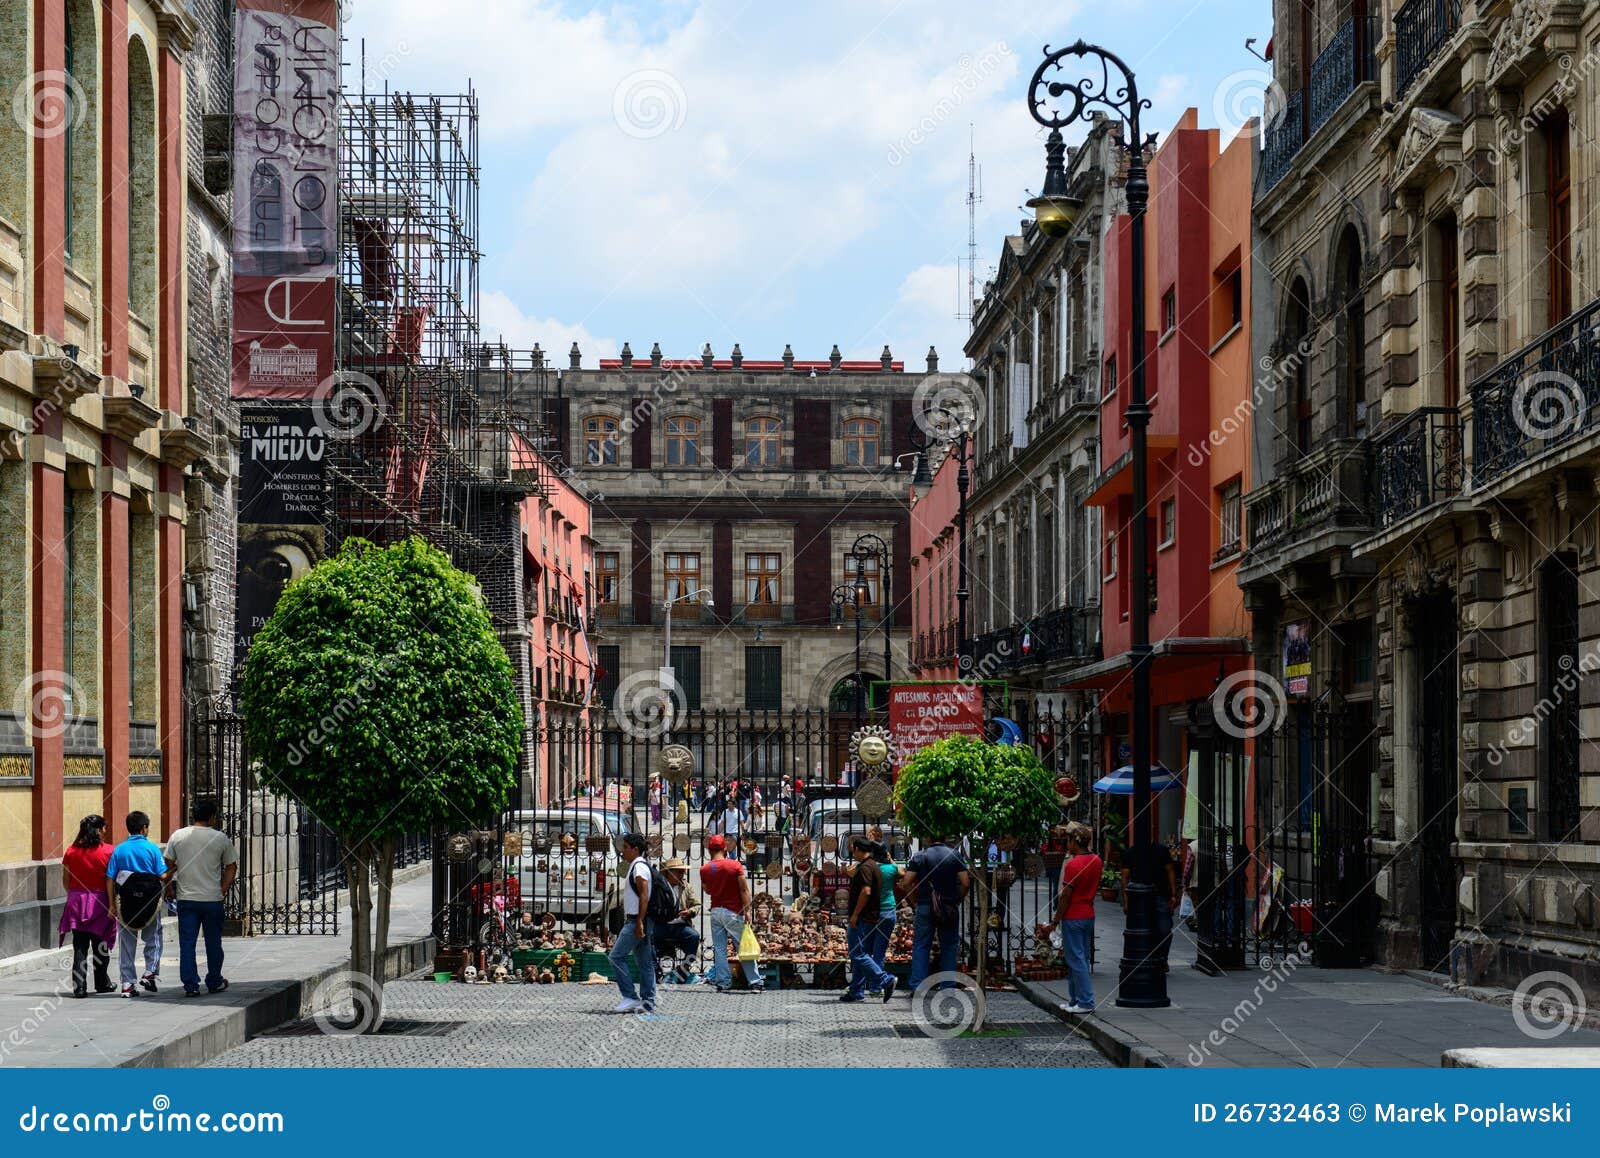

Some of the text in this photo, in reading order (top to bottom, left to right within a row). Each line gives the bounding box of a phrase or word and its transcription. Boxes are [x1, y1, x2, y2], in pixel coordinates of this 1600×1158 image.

[255, 98, 281, 242] PALACIO
[242, 425, 325, 461] EL MIEDO
[263, 482, 300, 491] HOMBRES
[918, 705, 959, 717] BARRO
